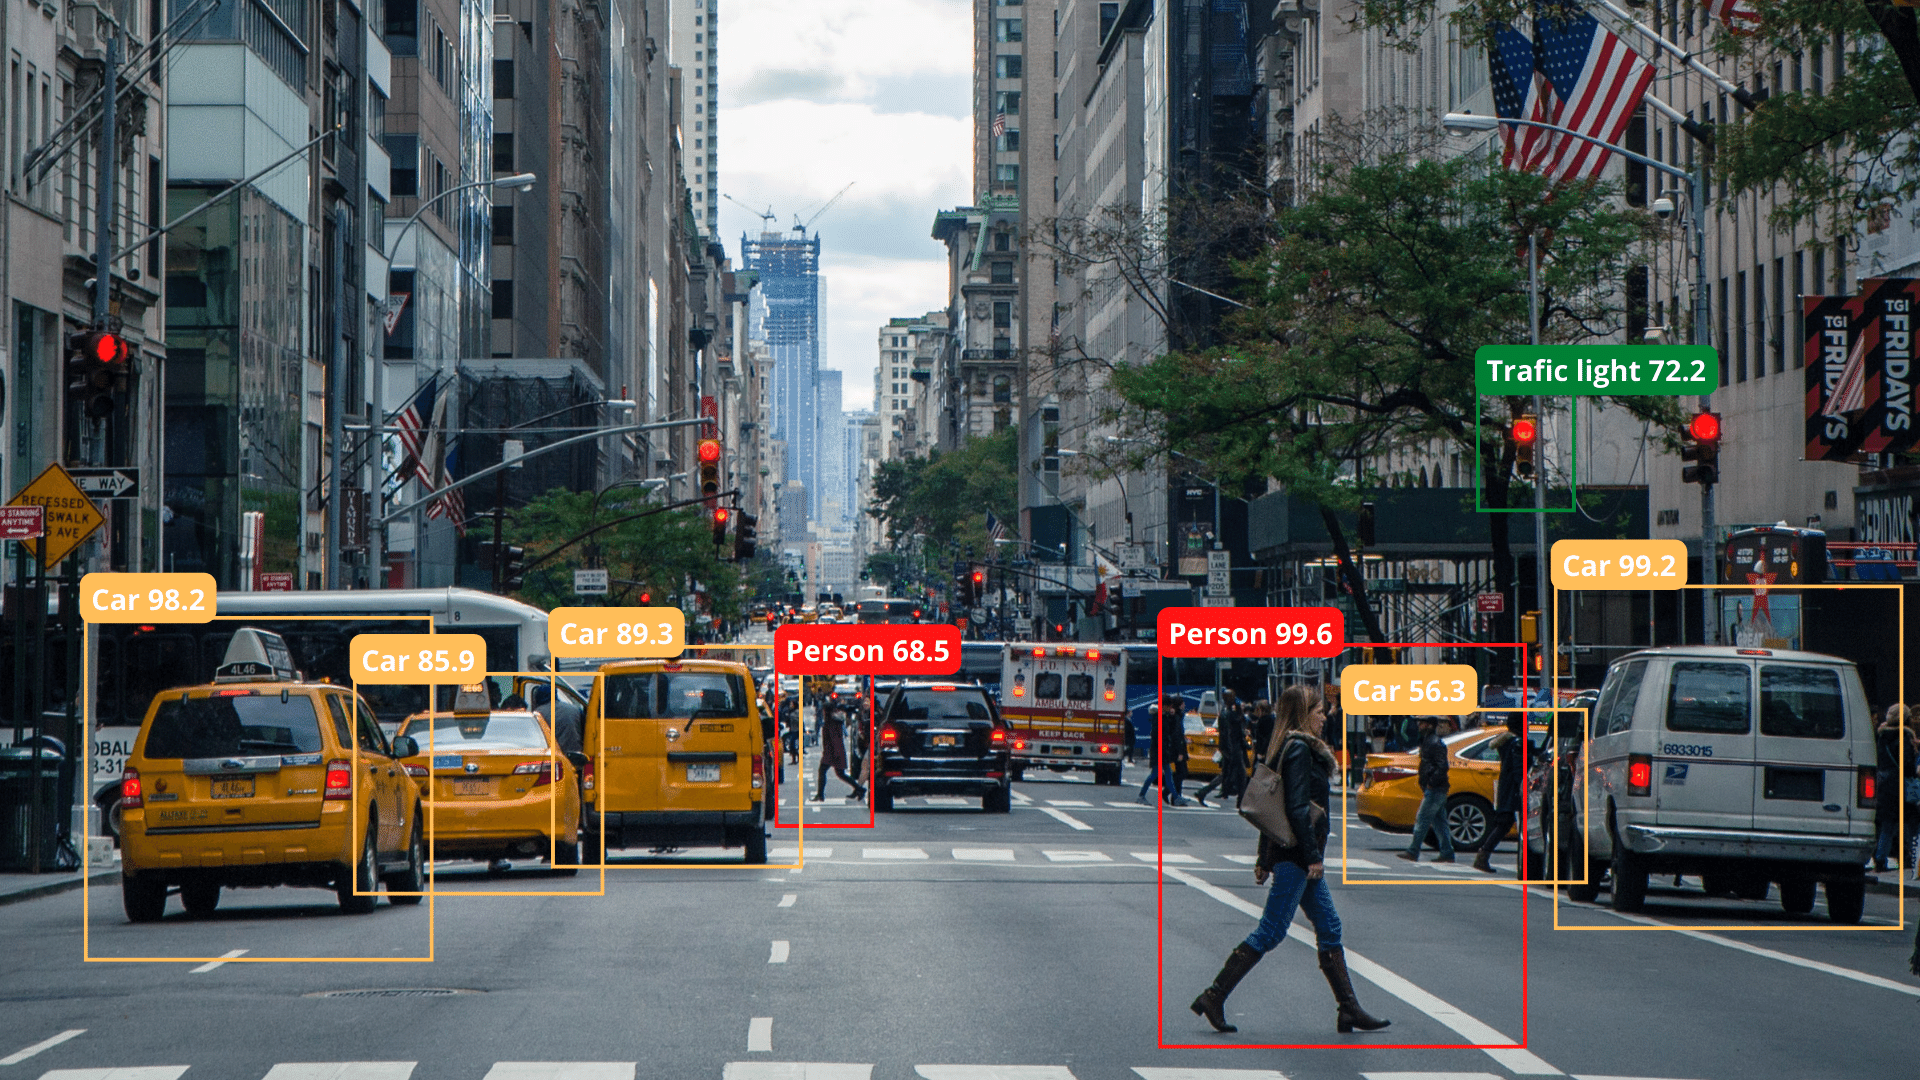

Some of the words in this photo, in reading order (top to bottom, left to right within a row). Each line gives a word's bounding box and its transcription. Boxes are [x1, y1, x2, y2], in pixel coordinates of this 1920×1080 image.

[1885, 299, 1909, 312] TGI
[1824, 316, 1848, 328] TGI
[1885, 314, 1910, 430] FRIDAYS
[1825, 330, 1848, 440] FRIDYS
[99, 478, 125, 489] WAY
[22, 495, 84, 509] RECESSED
[48, 511, 90, 524] SWALK
[56, 527, 79, 539] AVE
[454, 611, 461, 622] 8
[230, 664, 256, 675] 4L46
[1035, 698, 1091, 710] AMBULANCE
[1063, 731, 1085, 739] BACK
[1663, 743, 1713, 757] 6933015
